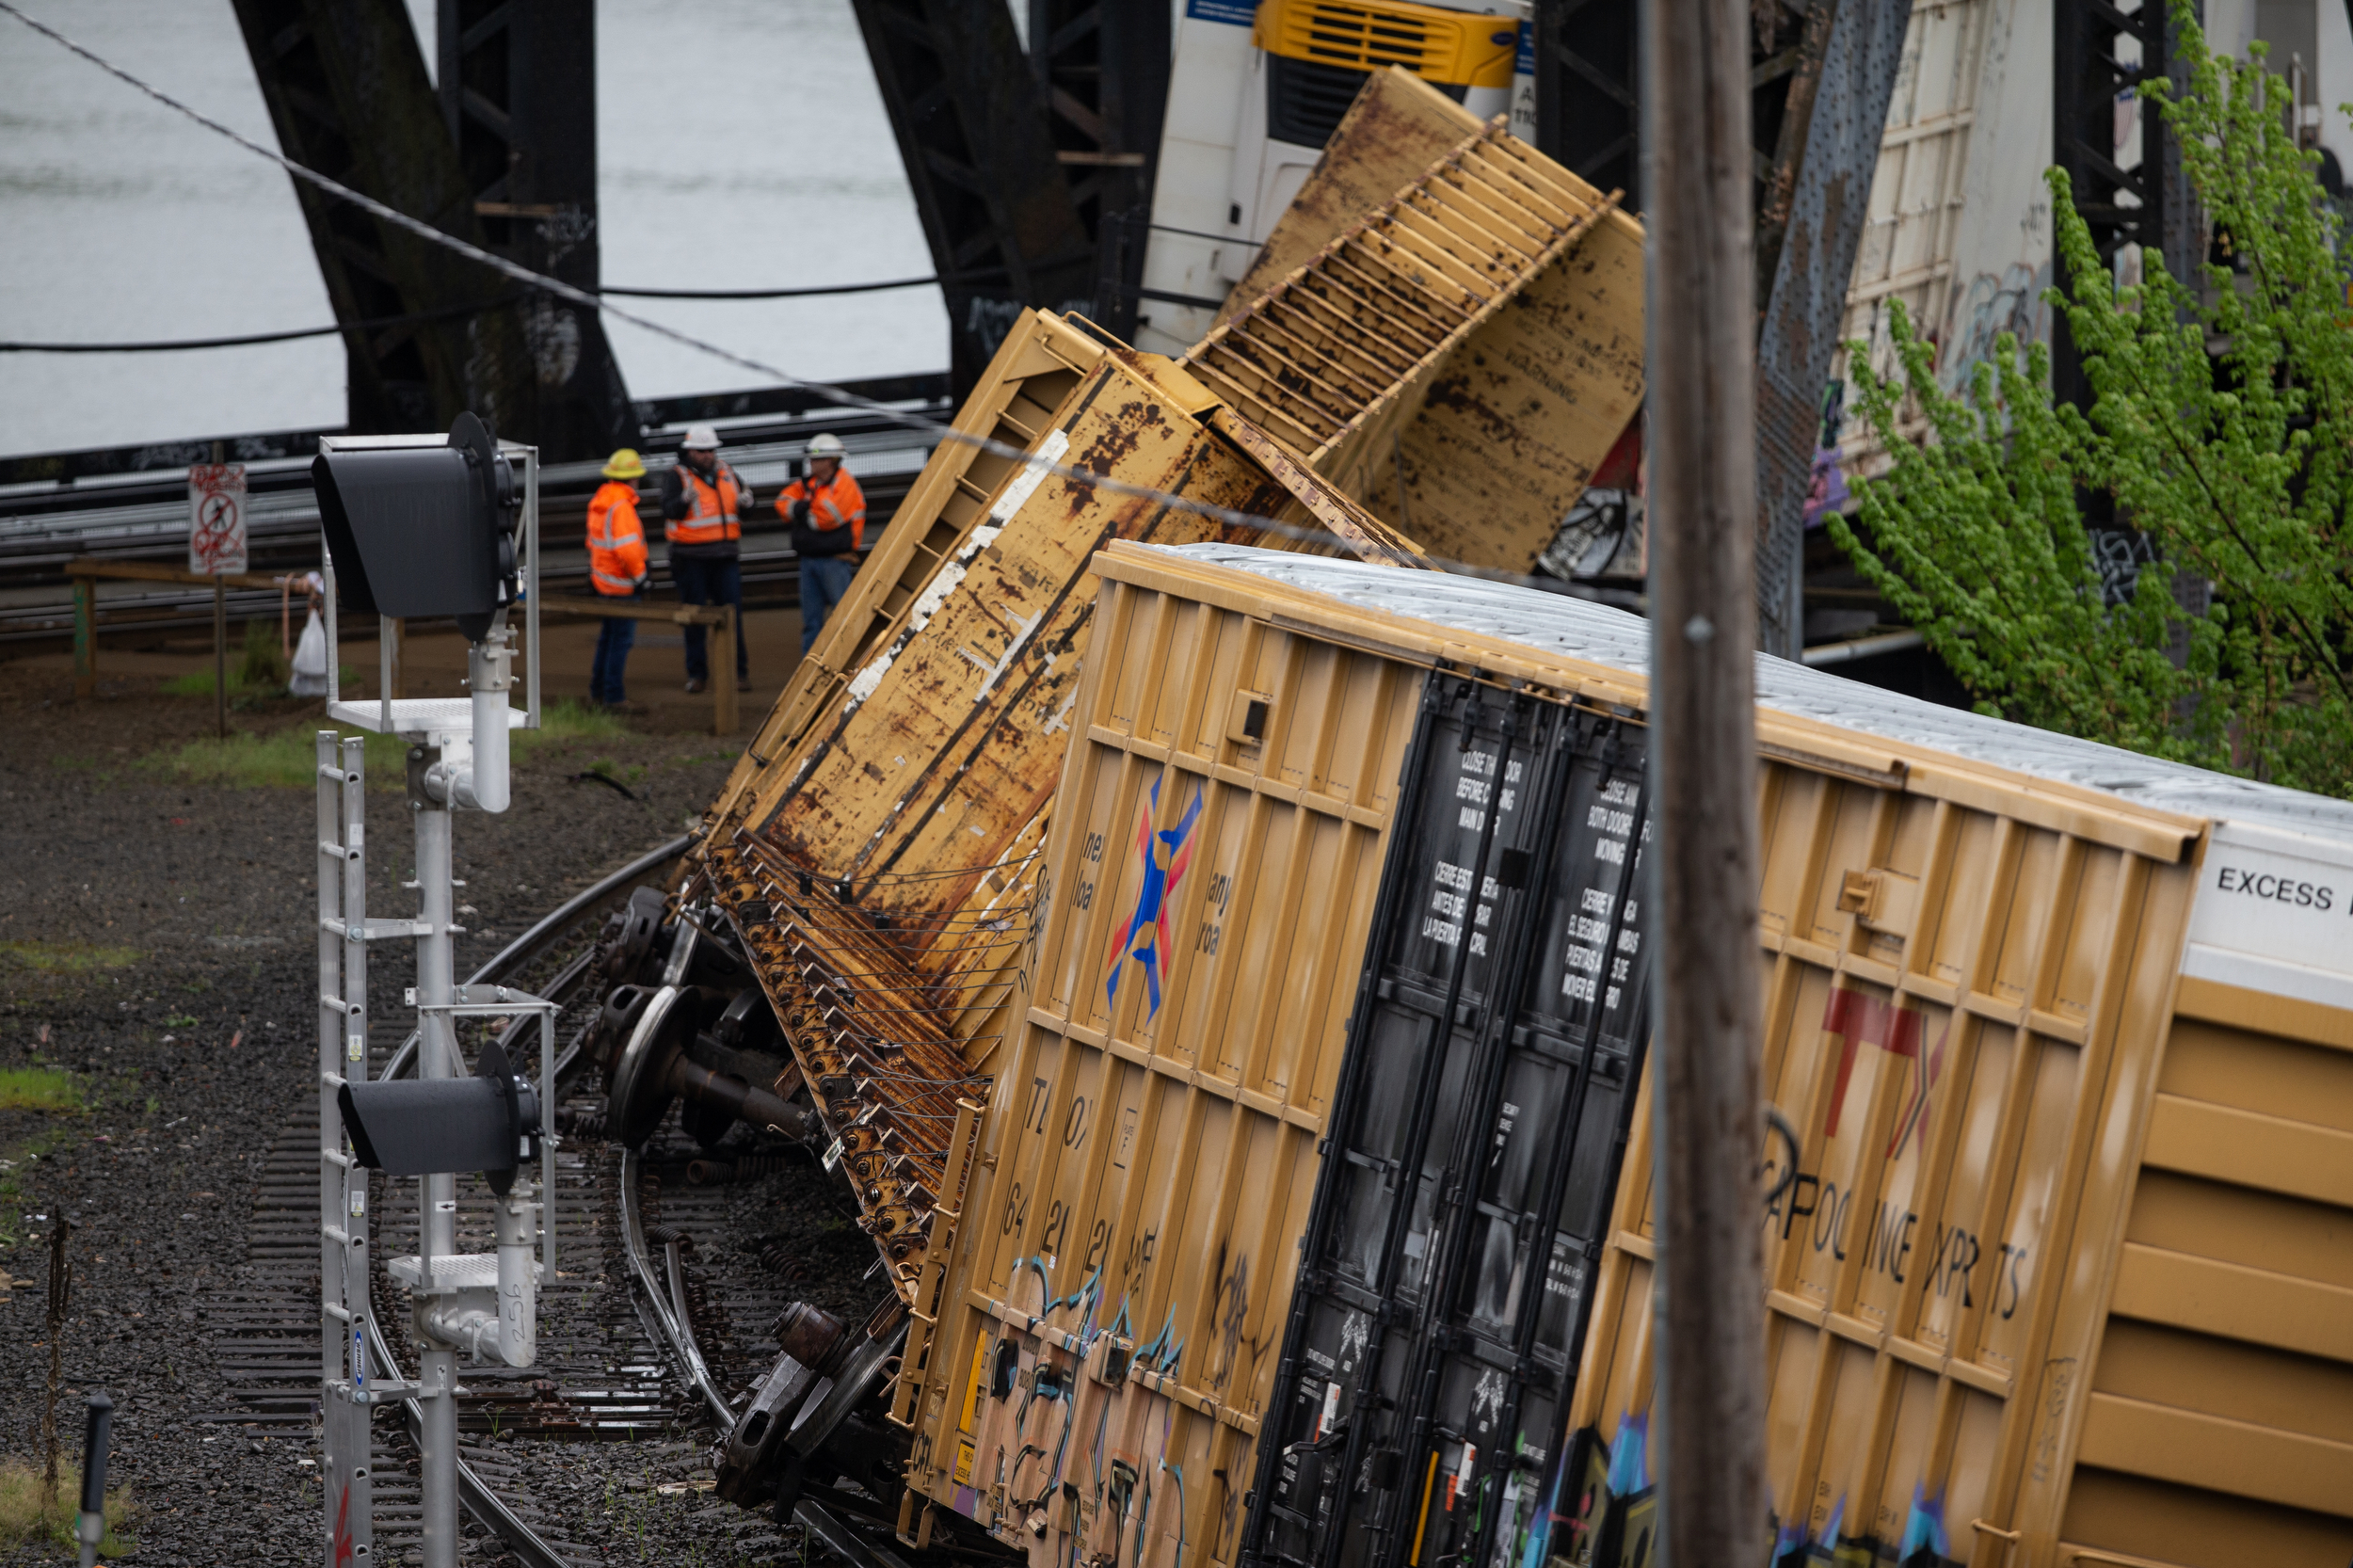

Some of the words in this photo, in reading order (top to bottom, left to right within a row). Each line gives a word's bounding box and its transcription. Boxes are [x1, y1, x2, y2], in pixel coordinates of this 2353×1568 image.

[1462, 750, 1485, 773] CLOSE
[1456, 776, 1484, 803] BEFORE
[1458, 806, 1479, 829] MAIN
[1587, 805, 1609, 829] BOTH
[1594, 837, 1626, 866] MOVING
[1434, 859, 1459, 887] CIERRE
[1072, 869, 1094, 911] loa
[1208, 872, 1231, 917] any
[1582, 887, 1608, 915] CIERRE
[2217, 866, 2334, 911] EXCESS
[1432, 889, 1454, 916] ANTES
[1451, 895, 1465, 919] DE
[1196, 921, 1221, 956] roa
[1422, 915, 1433, 937] LA
[1433, 918, 1457, 945] PUERTA
[1567, 914, 1577, 936] EL
[1576, 916, 1607, 944] SEGURO
[1565, 943, 1596, 973] PUERTAS
[1561, 972, 1588, 1000] MOVER
[1585, 979, 1596, 1004] EL
[504, 1283, 526, 1343] 256
[355, 1341, 363, 1375] WERNER
